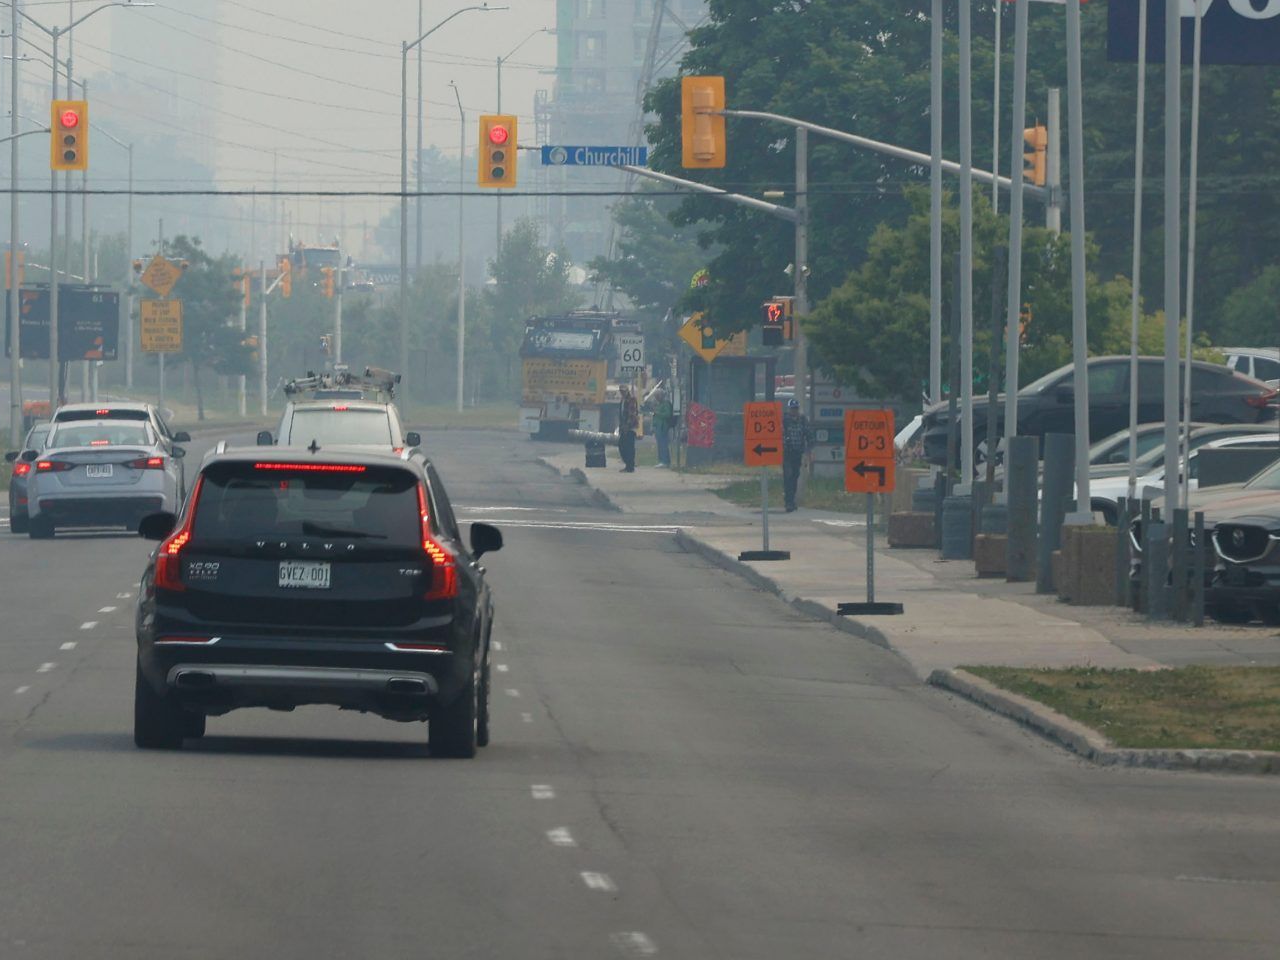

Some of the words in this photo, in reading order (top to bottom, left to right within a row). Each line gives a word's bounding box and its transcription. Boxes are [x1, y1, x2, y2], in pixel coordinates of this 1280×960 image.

[575, 147, 639, 165] Churchill
[624, 348, 641, 362] 60
[754, 420, 776, 433] D-3
[854, 421, 885, 430] DETOUR
[858, 435, 886, 450] D-3
[256, 541, 355, 550] VOLVO
